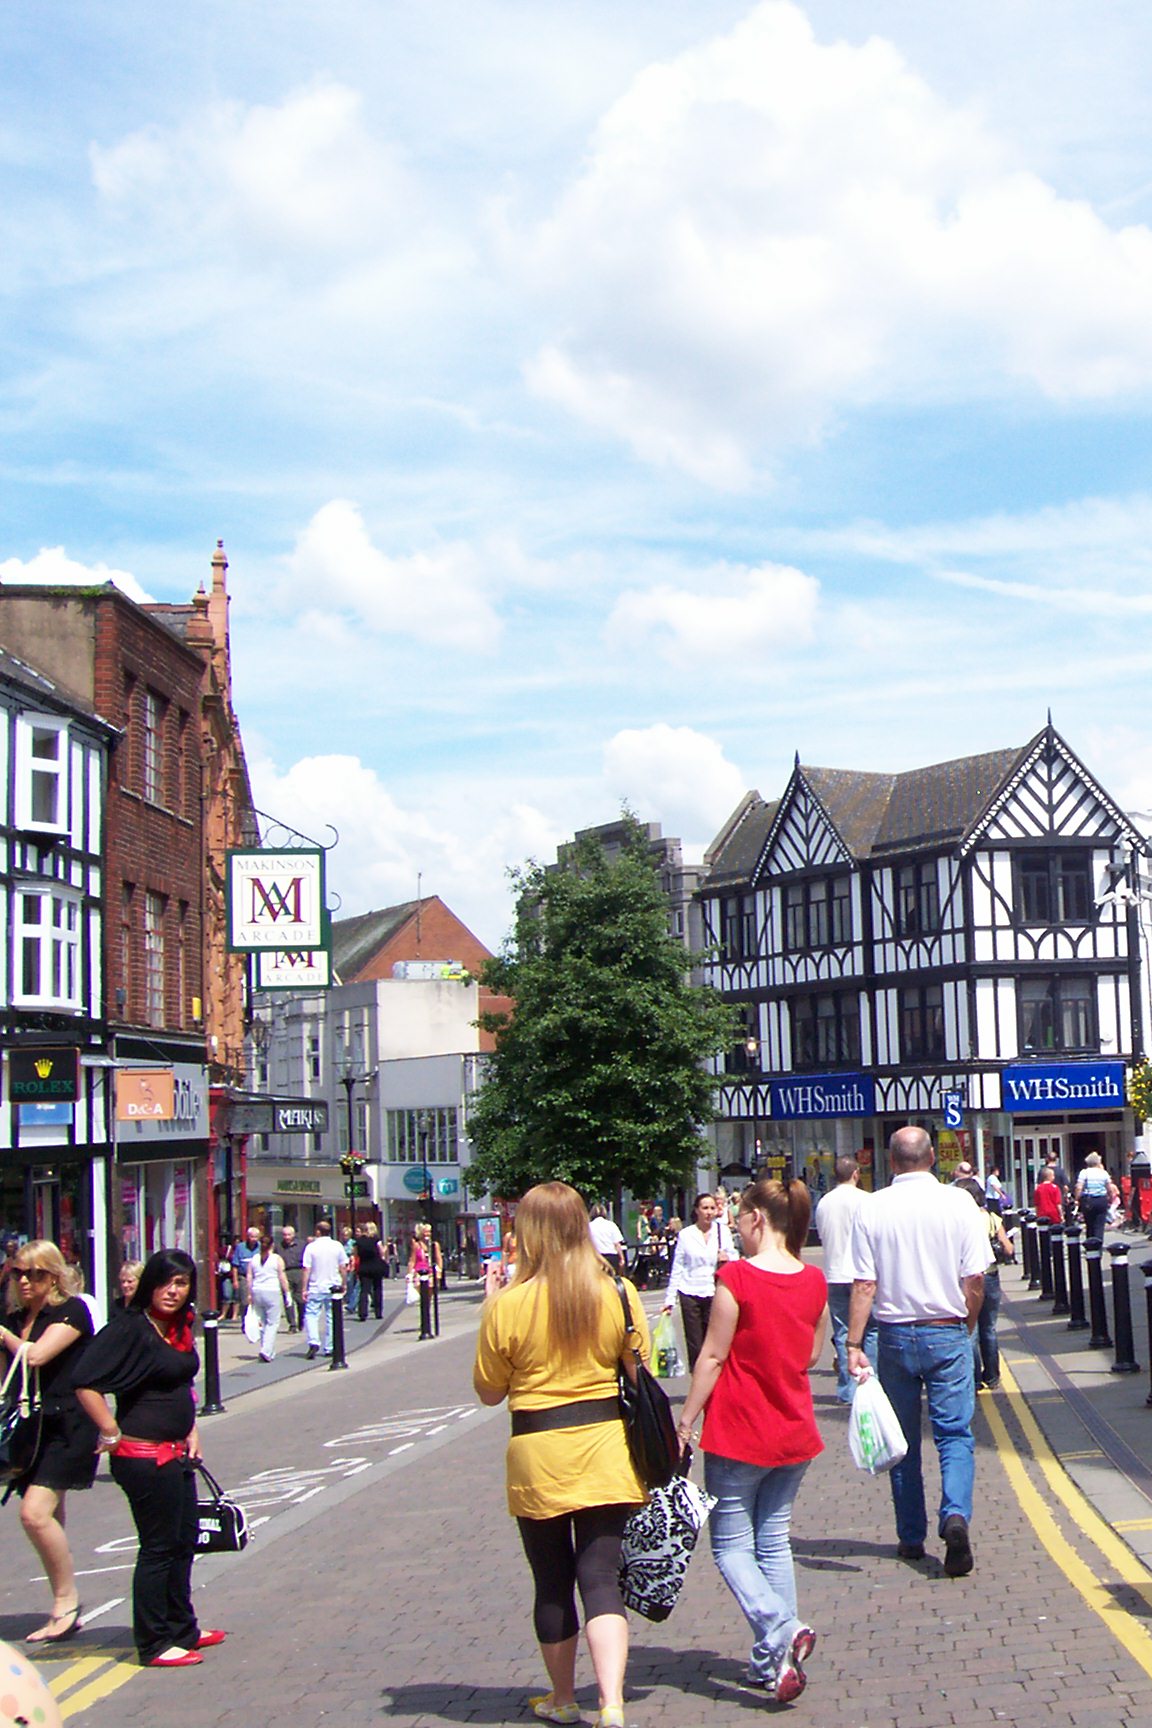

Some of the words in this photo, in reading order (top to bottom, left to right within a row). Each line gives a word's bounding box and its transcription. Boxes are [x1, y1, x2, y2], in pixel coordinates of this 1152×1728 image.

[238, 931, 316, 942] ARCADE
[13, 1080, 74, 1094] ROLEX
[778, 1084, 865, 1115] WHSmith
[1008, 1075, 1119, 1101] WHSmith
[947, 1101, 961, 1126] S
